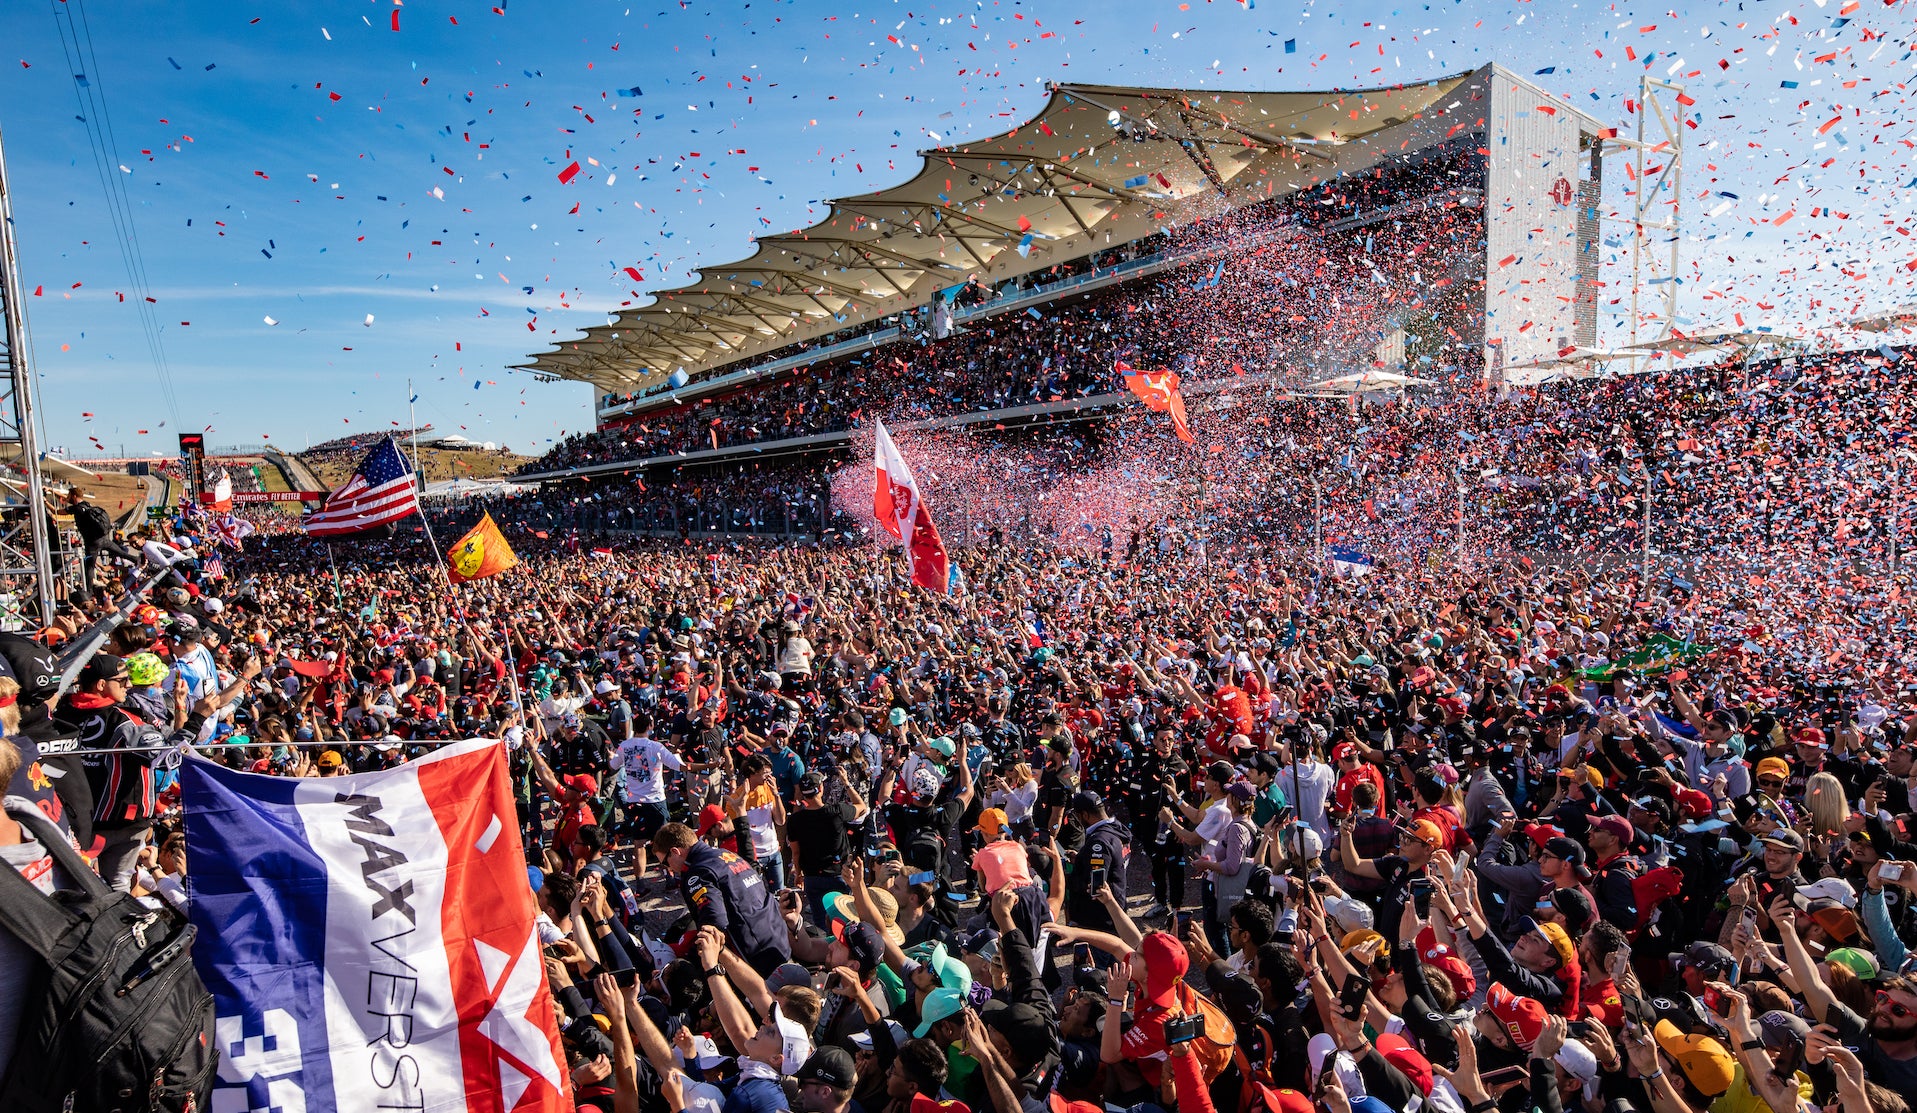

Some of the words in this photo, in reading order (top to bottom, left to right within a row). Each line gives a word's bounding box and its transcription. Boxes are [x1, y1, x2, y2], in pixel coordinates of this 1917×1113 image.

[231, 493, 268, 501] Emirates
[271, 492, 280, 501] FLY
[280, 492, 300, 501] BETTER
